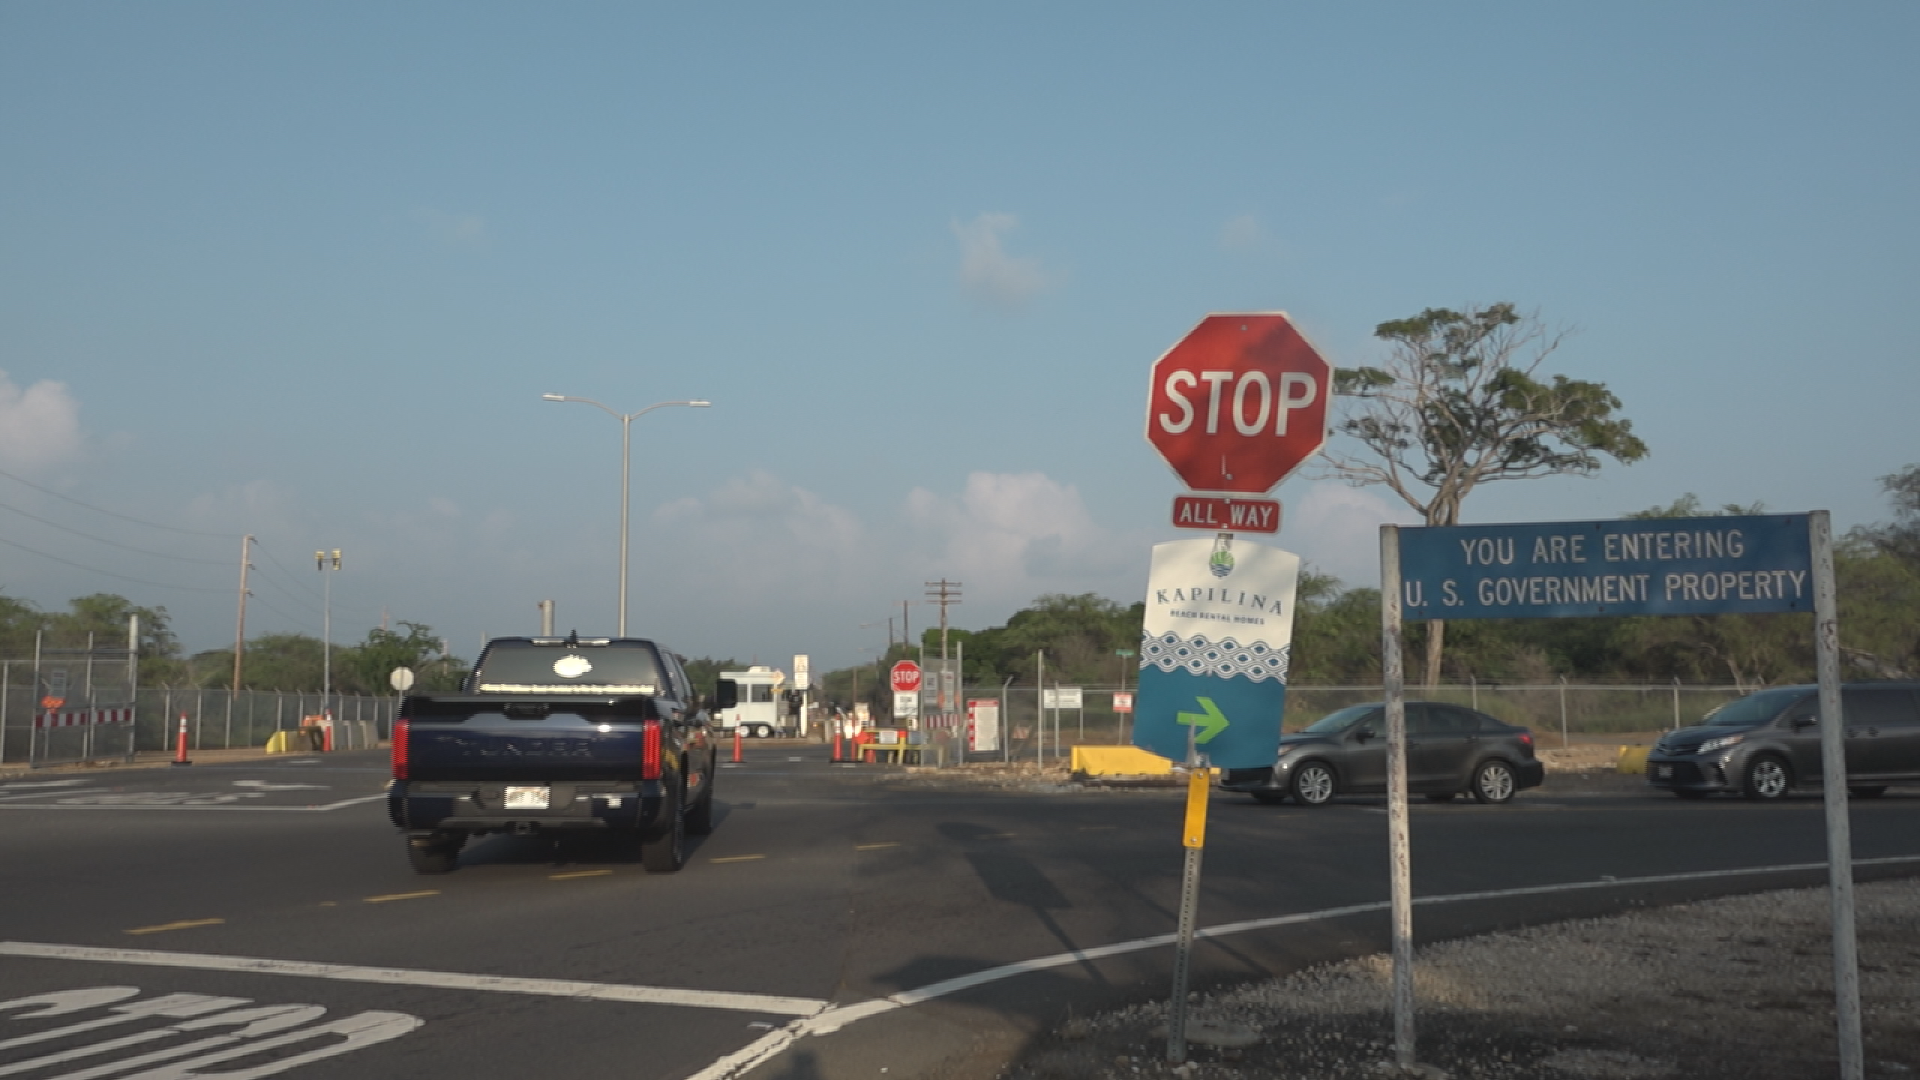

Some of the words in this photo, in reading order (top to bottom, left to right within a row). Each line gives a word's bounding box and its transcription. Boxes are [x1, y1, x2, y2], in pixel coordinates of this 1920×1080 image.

[1158, 370, 1317, 437] STOP
[1179, 502, 1217, 523] ALL
[1230, 504, 1273, 528] WAY
[1460, 538, 1515, 565] YOU
[1532, 534, 1587, 564] ARE
[1604, 529, 1744, 562] ENTERING
[1156, 587, 1282, 616] KAPILINA
[1405, 580, 1428, 607] U.
[1442, 578, 1464, 607] S.
[1478, 574, 1650, 606] GOVERNMENT
[1665, 570, 1806, 601] PROPERTY
[1234, 616, 1265, 625] HOMES
[893, 671, 919, 684] STOP
